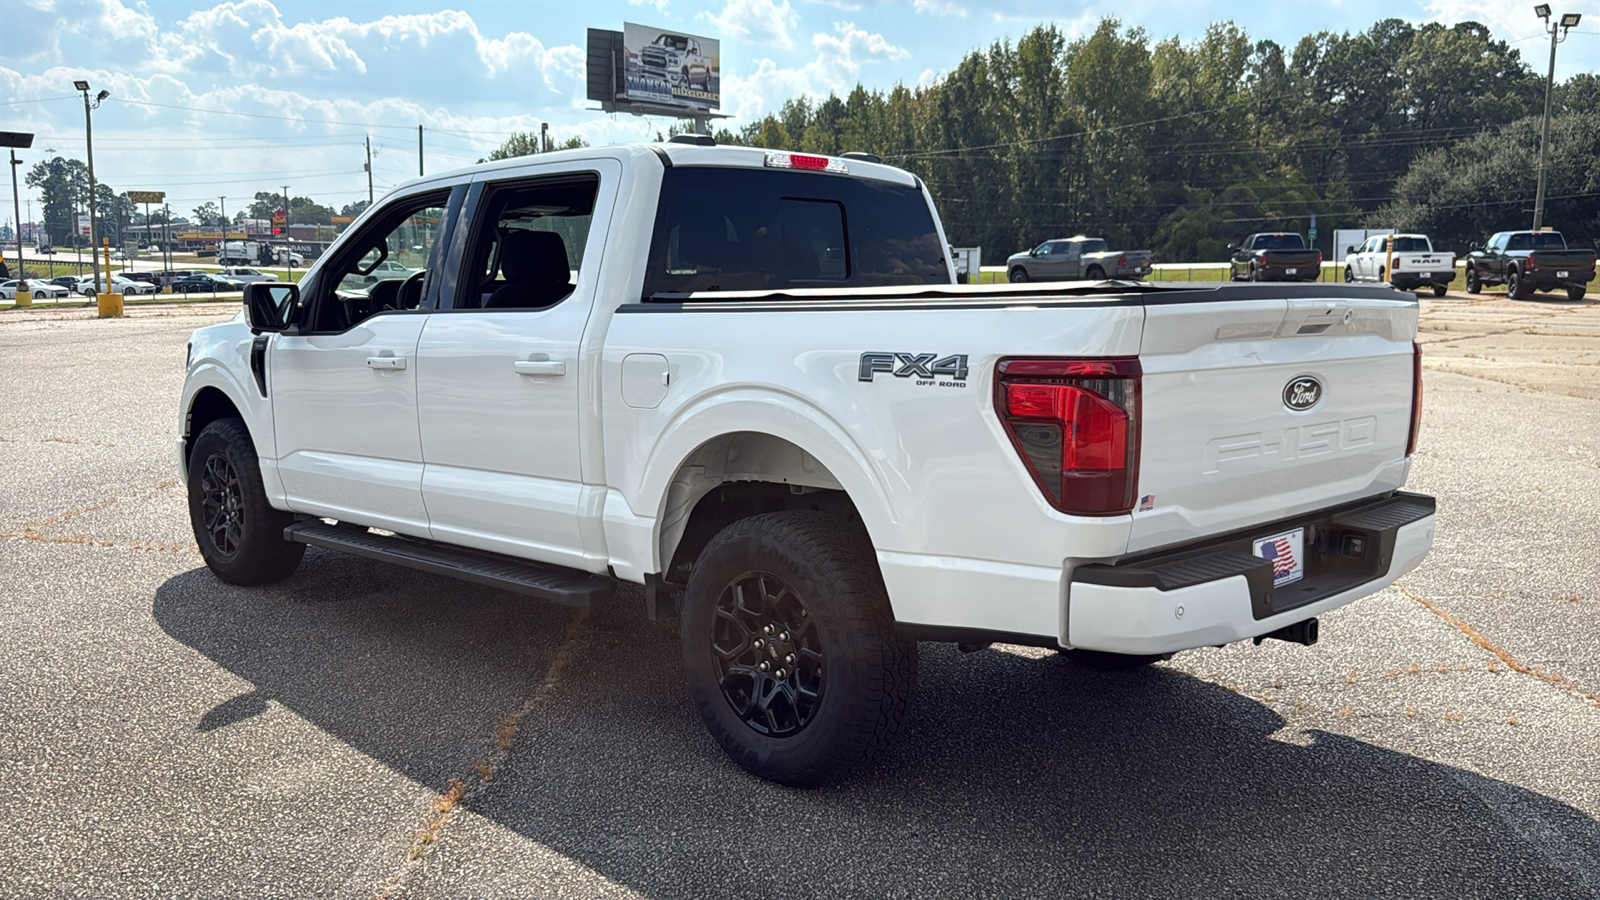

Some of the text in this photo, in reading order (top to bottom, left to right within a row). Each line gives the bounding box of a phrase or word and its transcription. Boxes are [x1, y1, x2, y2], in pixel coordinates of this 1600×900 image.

[627, 76, 672, 95] THOMSON
[858, 351, 969, 382] FX4
[1290, 381, 1318, 405] Ford
[1202, 415, 1377, 475] F-150
